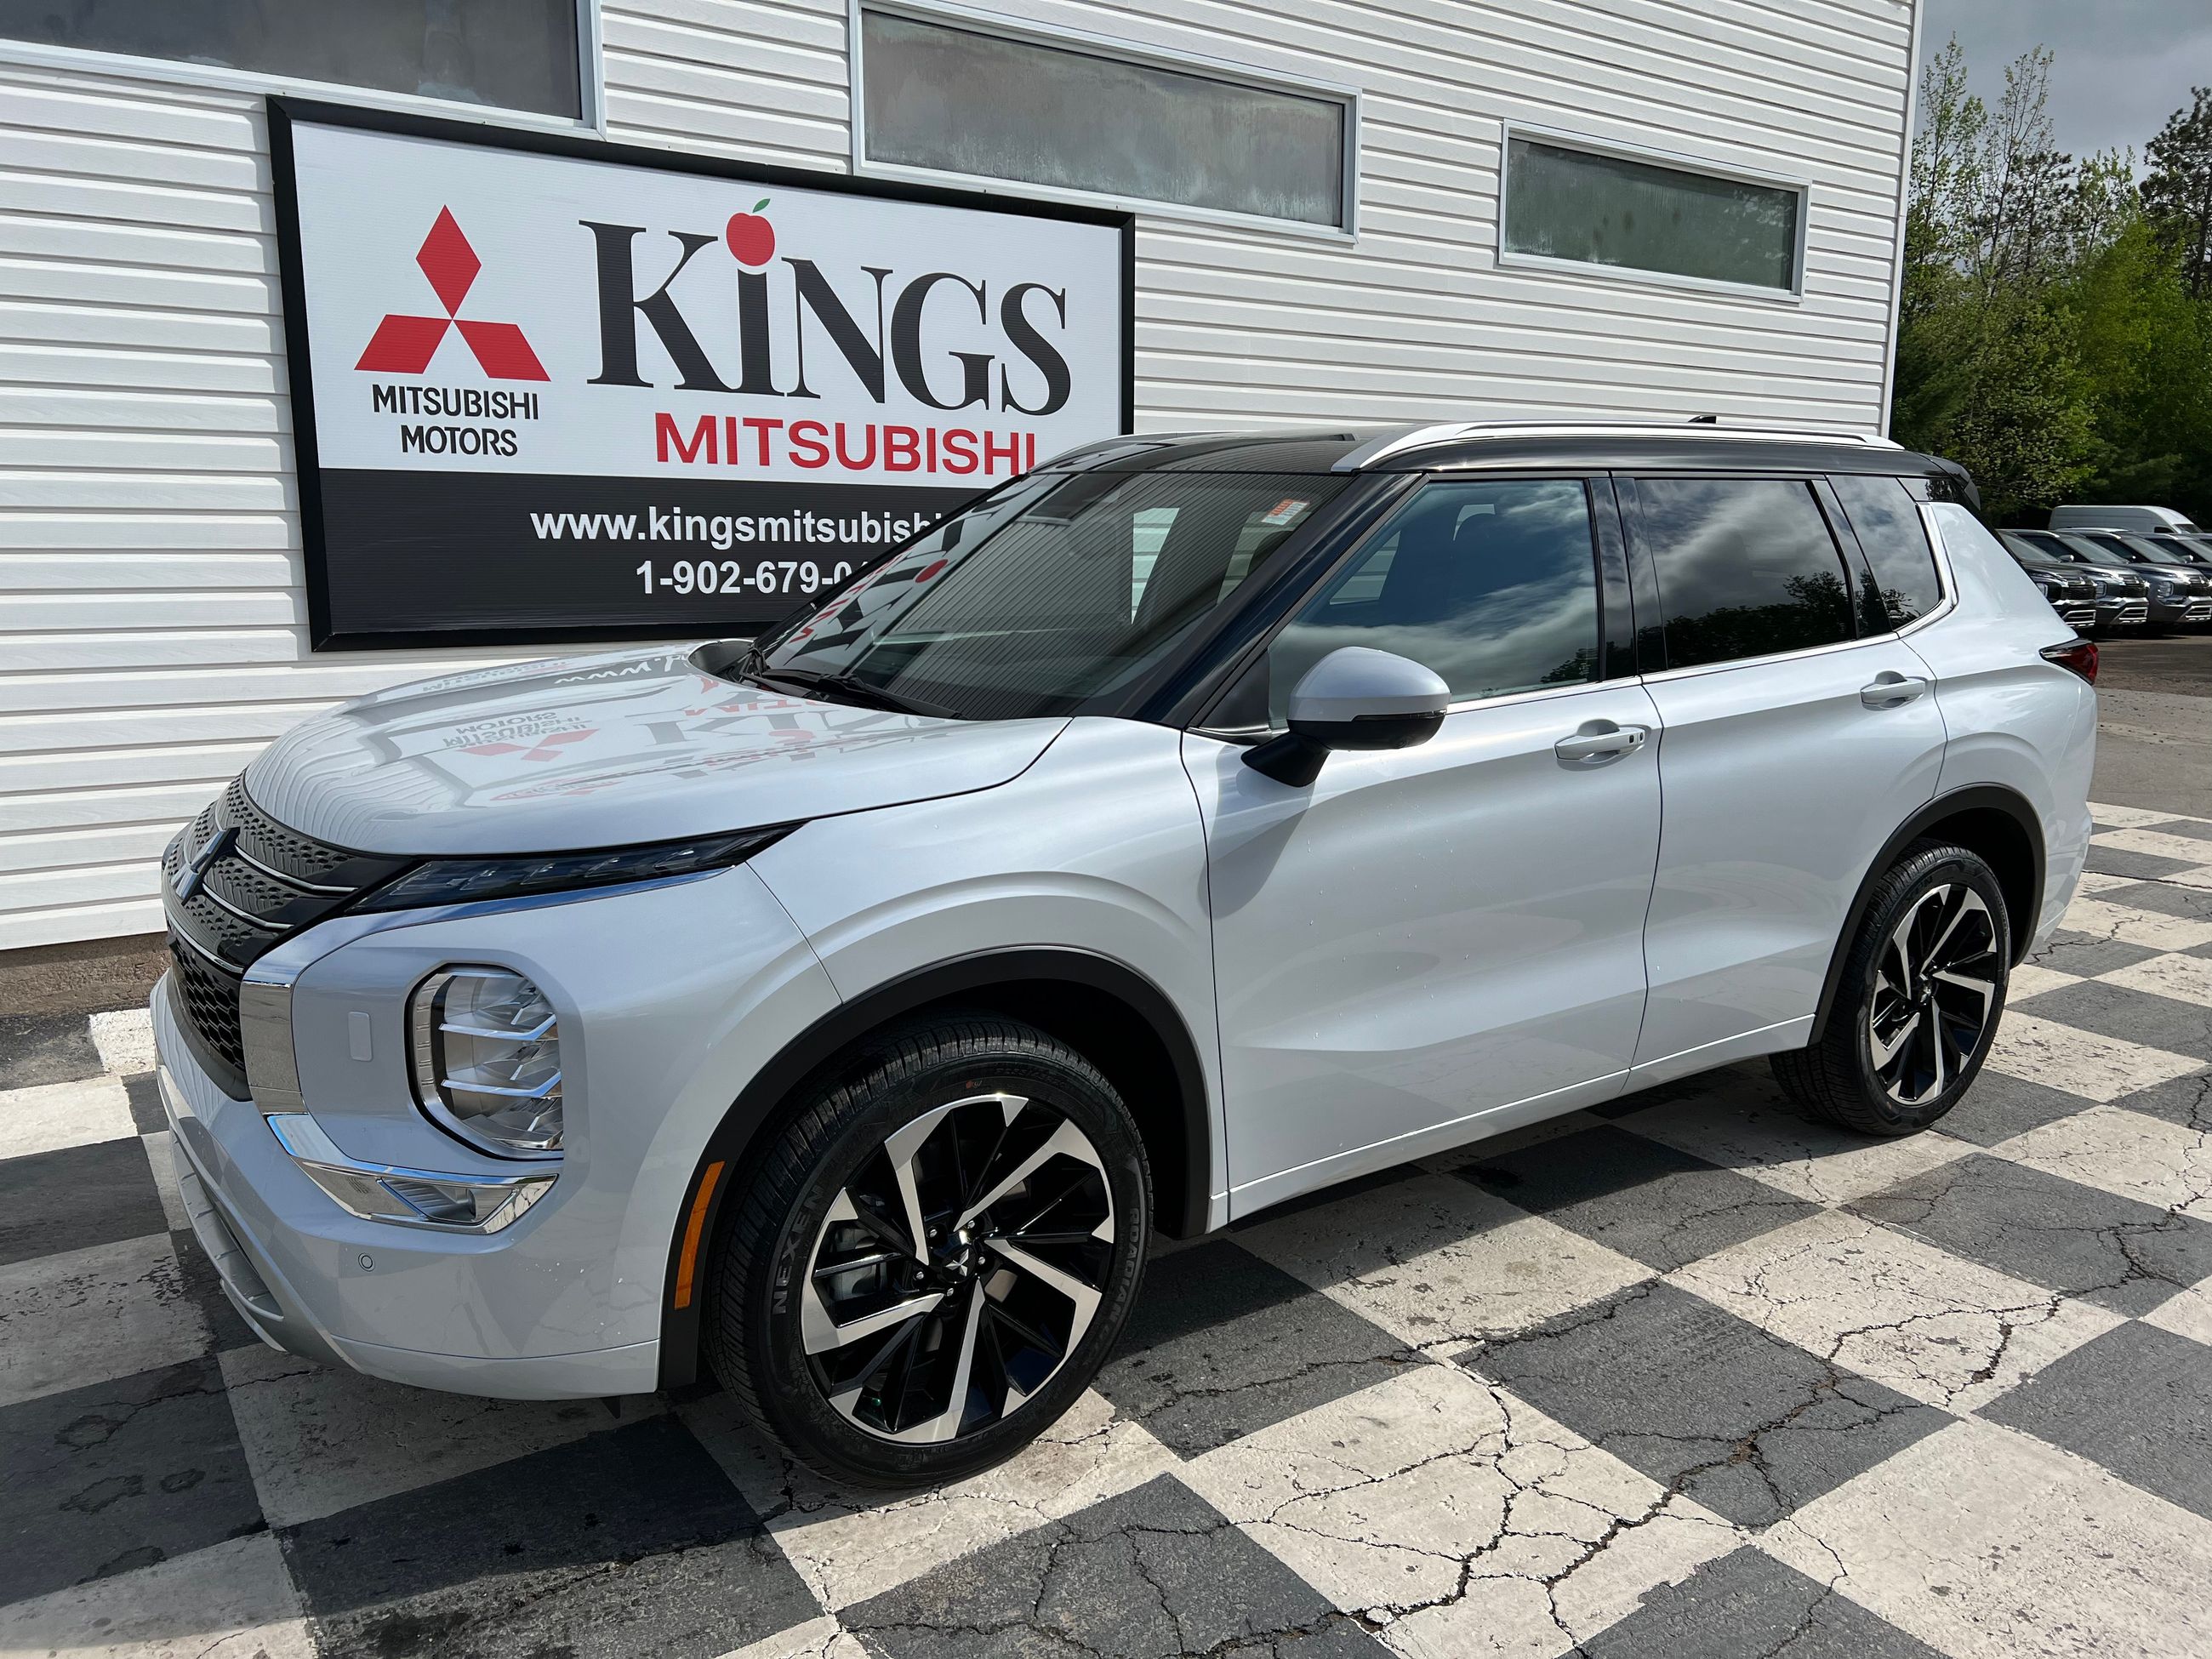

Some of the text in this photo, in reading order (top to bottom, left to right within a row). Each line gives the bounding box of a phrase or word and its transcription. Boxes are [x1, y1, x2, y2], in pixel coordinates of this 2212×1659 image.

[372, 384, 539, 420] MITSUBISHI
[400, 425, 518, 457] MOTORS
[654, 412, 1036, 476] MITSUBISHI
[636, 559, 869, 595] 1-902-679-0
[771, 1184, 825, 1315] NEXEN
[1109, 1206, 1140, 1322] ROADIAN
